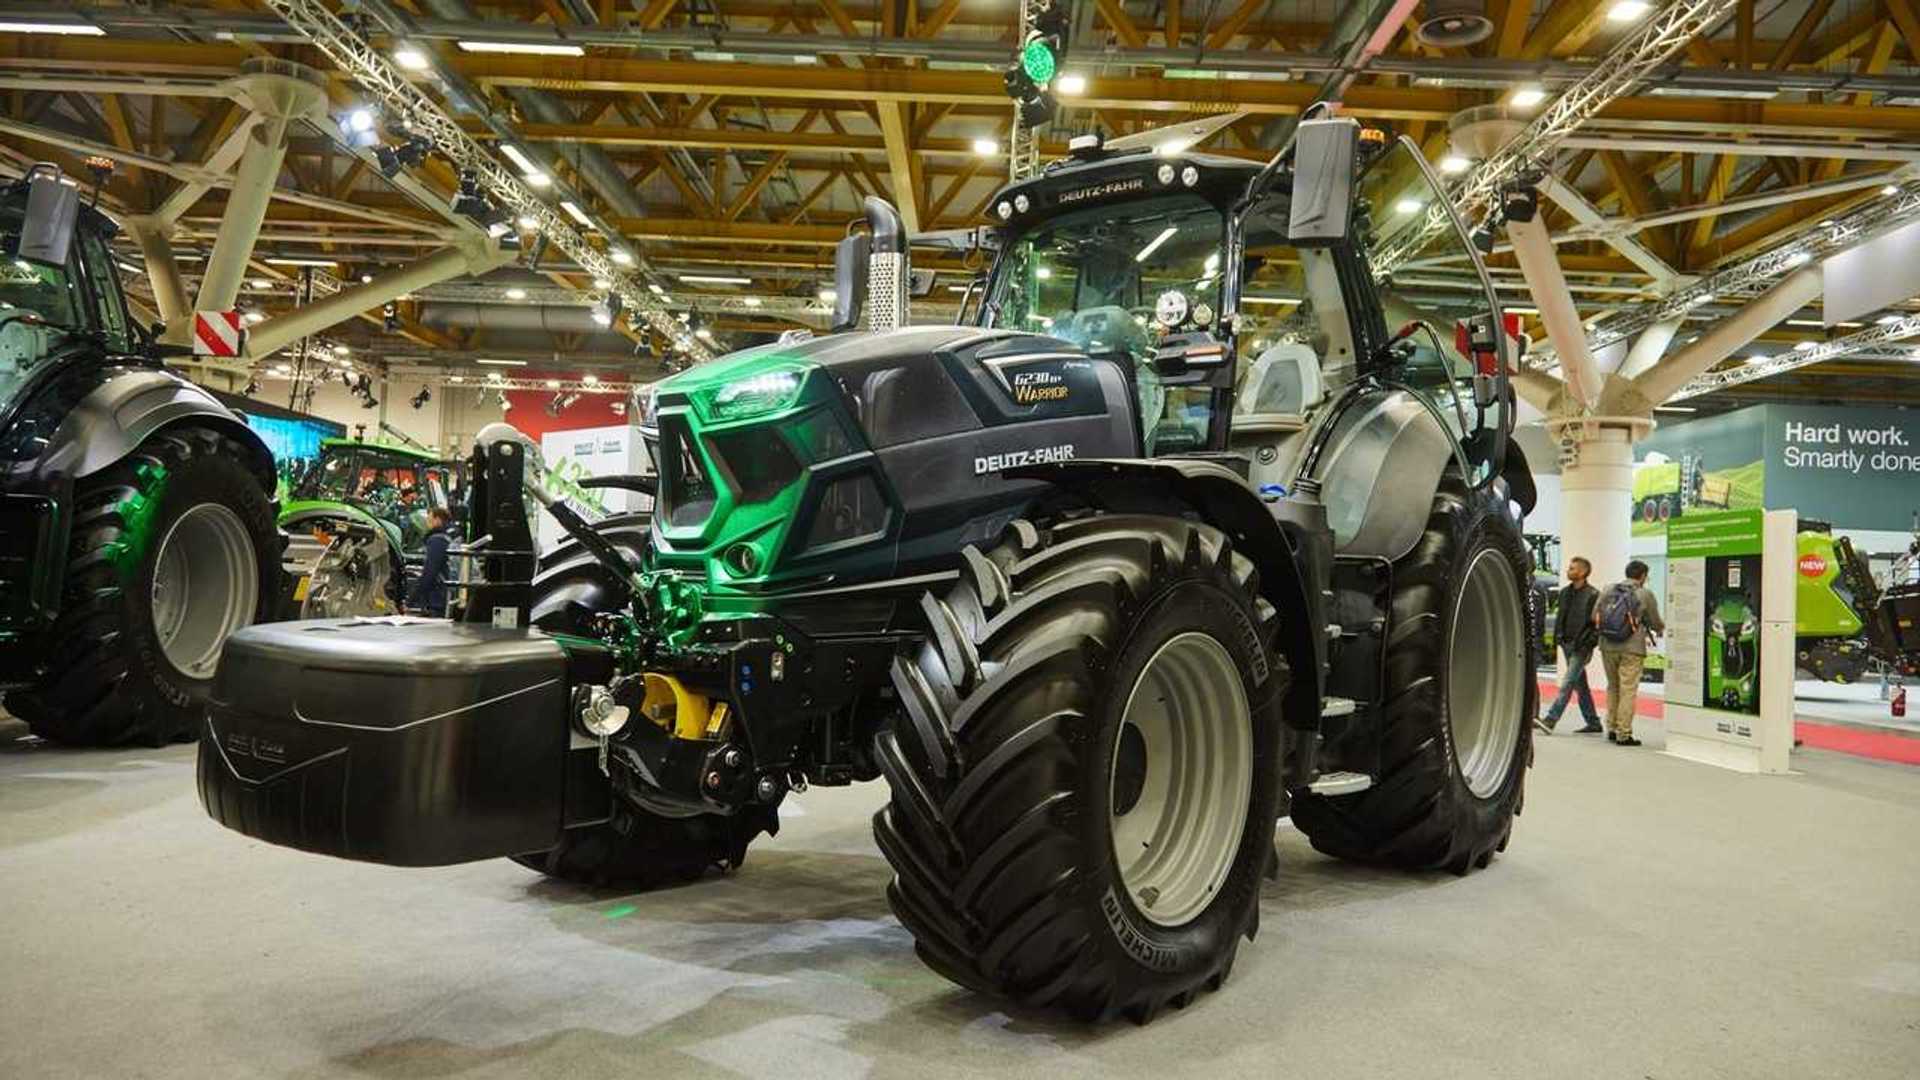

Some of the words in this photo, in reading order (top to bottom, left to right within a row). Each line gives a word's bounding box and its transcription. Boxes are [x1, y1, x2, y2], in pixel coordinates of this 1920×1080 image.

[1058, 179, 1144, 203] DEUTZ-FAHR
[1785, 421, 1840, 444] Hard
[1847, 425, 1909, 446] work.
[974, 444, 1075, 475] DEUTZ-FAHR
[1784, 446, 1865, 474] Smartly
[1870, 450, 1920, 472] done
[1799, 560, 1825, 571] NEW
[1101, 893, 1181, 970] MICHELIN
